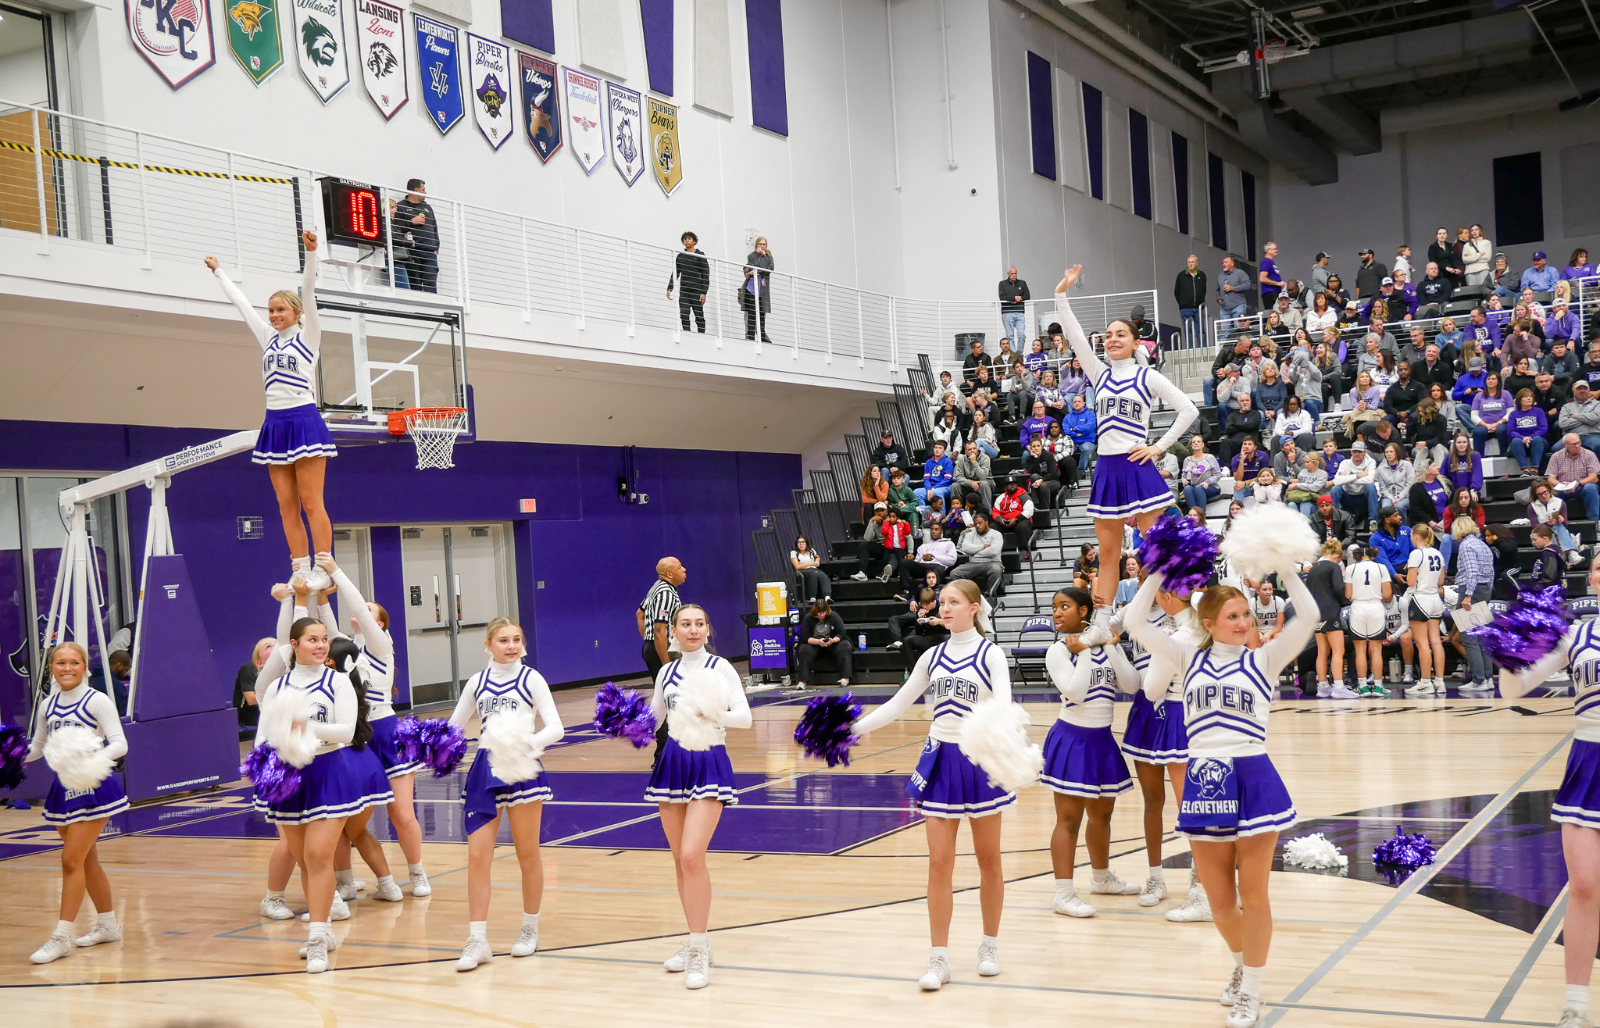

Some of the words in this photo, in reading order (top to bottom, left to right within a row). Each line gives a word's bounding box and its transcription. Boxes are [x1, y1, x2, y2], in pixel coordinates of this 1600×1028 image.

[297, 0, 337, 17] Wildcats
[359, 1, 399, 23] LANSING
[140, 0, 198, 60] KC
[366, 18, 395, 38] Lions
[417, 19, 455, 43] LEAVENWORTH
[425, 35, 450, 56] Pioneers
[477, 40, 502, 59] PIPER
[475, 51, 504, 73] Pirates
[523, 56, 554, 76] SEAMAN
[525, 68, 553, 89] Vikings
[612, 98, 639, 118] Chargers
[627, 94, 638, 104] WEST
[650, 101, 676, 117] TURNER
[650, 110, 675, 131] Bears
[351, 191, 379, 238] 10
[263, 352, 299, 375] IPER
[176, 456, 195, 467] SPORTS
[195, 450, 216, 461] SYSTEMS
[1428, 555, 1442, 572] 23
[1364, 569, 1371, 586] 1
[1488, 601, 1508, 612] PER
[1572, 599, 1600, 611] PIPE
[1026, 617, 1051, 628] PIPER
[930, 676, 979, 704] PIPER
[1186, 683, 1256, 718] PIPER
[910, 770, 928, 792] HYPE
